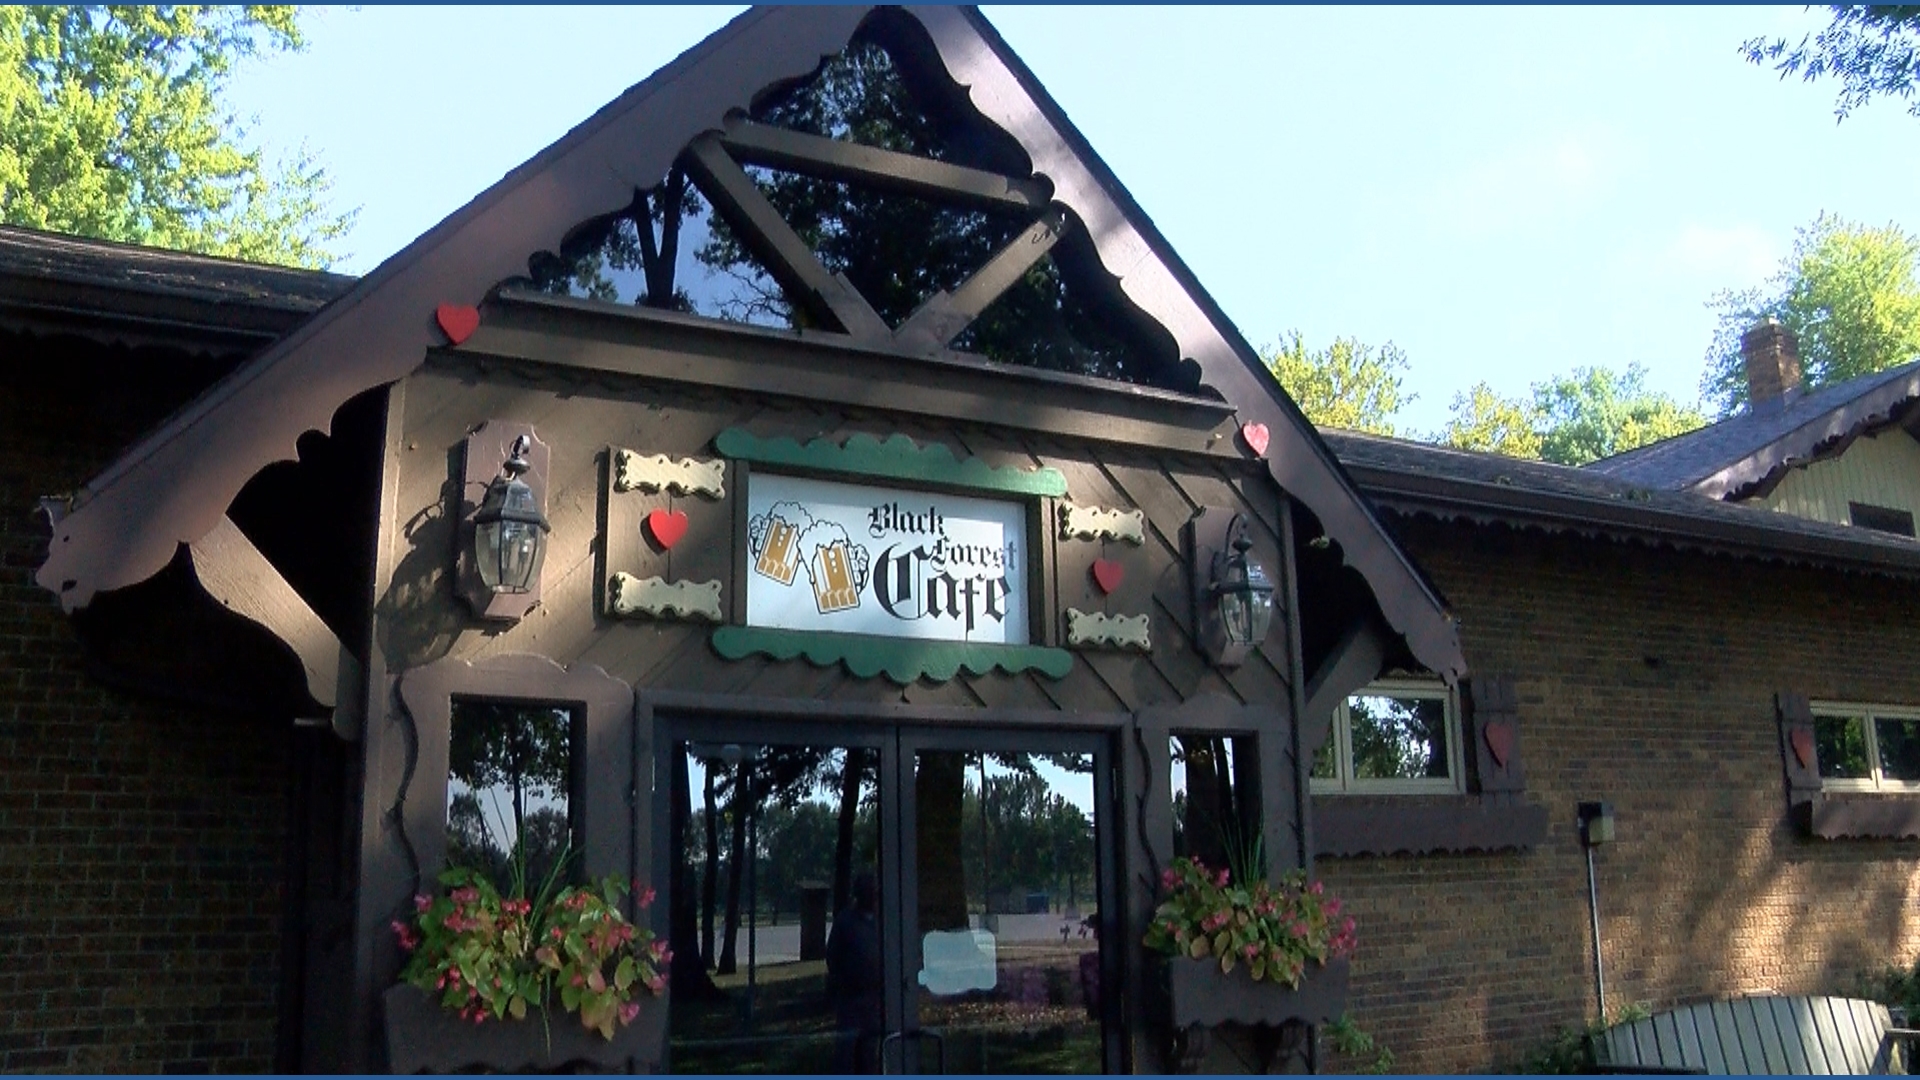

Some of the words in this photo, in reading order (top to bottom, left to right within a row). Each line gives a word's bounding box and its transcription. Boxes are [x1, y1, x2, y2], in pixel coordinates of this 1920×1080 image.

[868, 502, 945, 538] Black
[931, 536, 1017, 572] Forest
[873, 542, 1011, 641] Cafe
